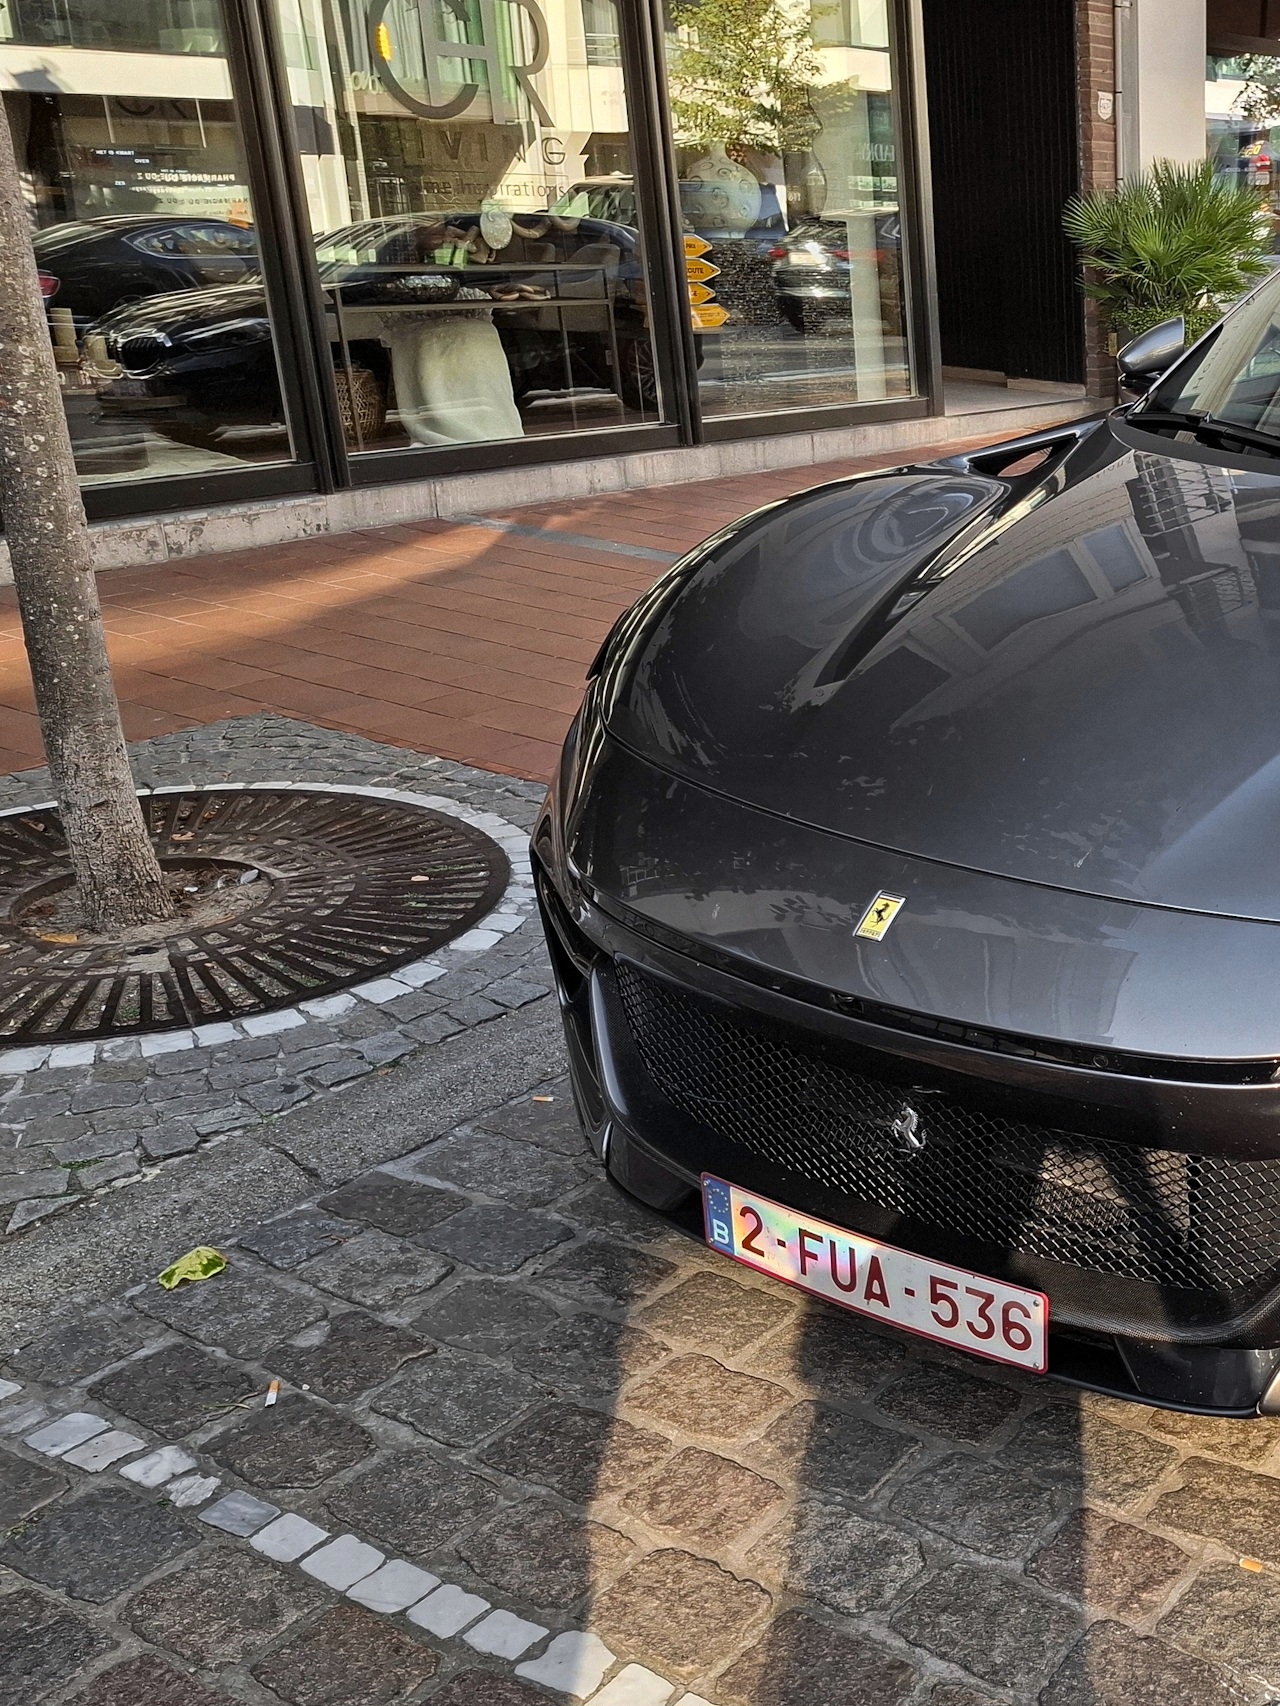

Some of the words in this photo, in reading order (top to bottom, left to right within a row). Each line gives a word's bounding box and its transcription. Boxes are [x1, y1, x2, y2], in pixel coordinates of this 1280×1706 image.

[386, 127, 566, 166] IVING
[712, 1218, 730, 1245] B
[738, 1205, 1034, 1353] 2-FUA-536
